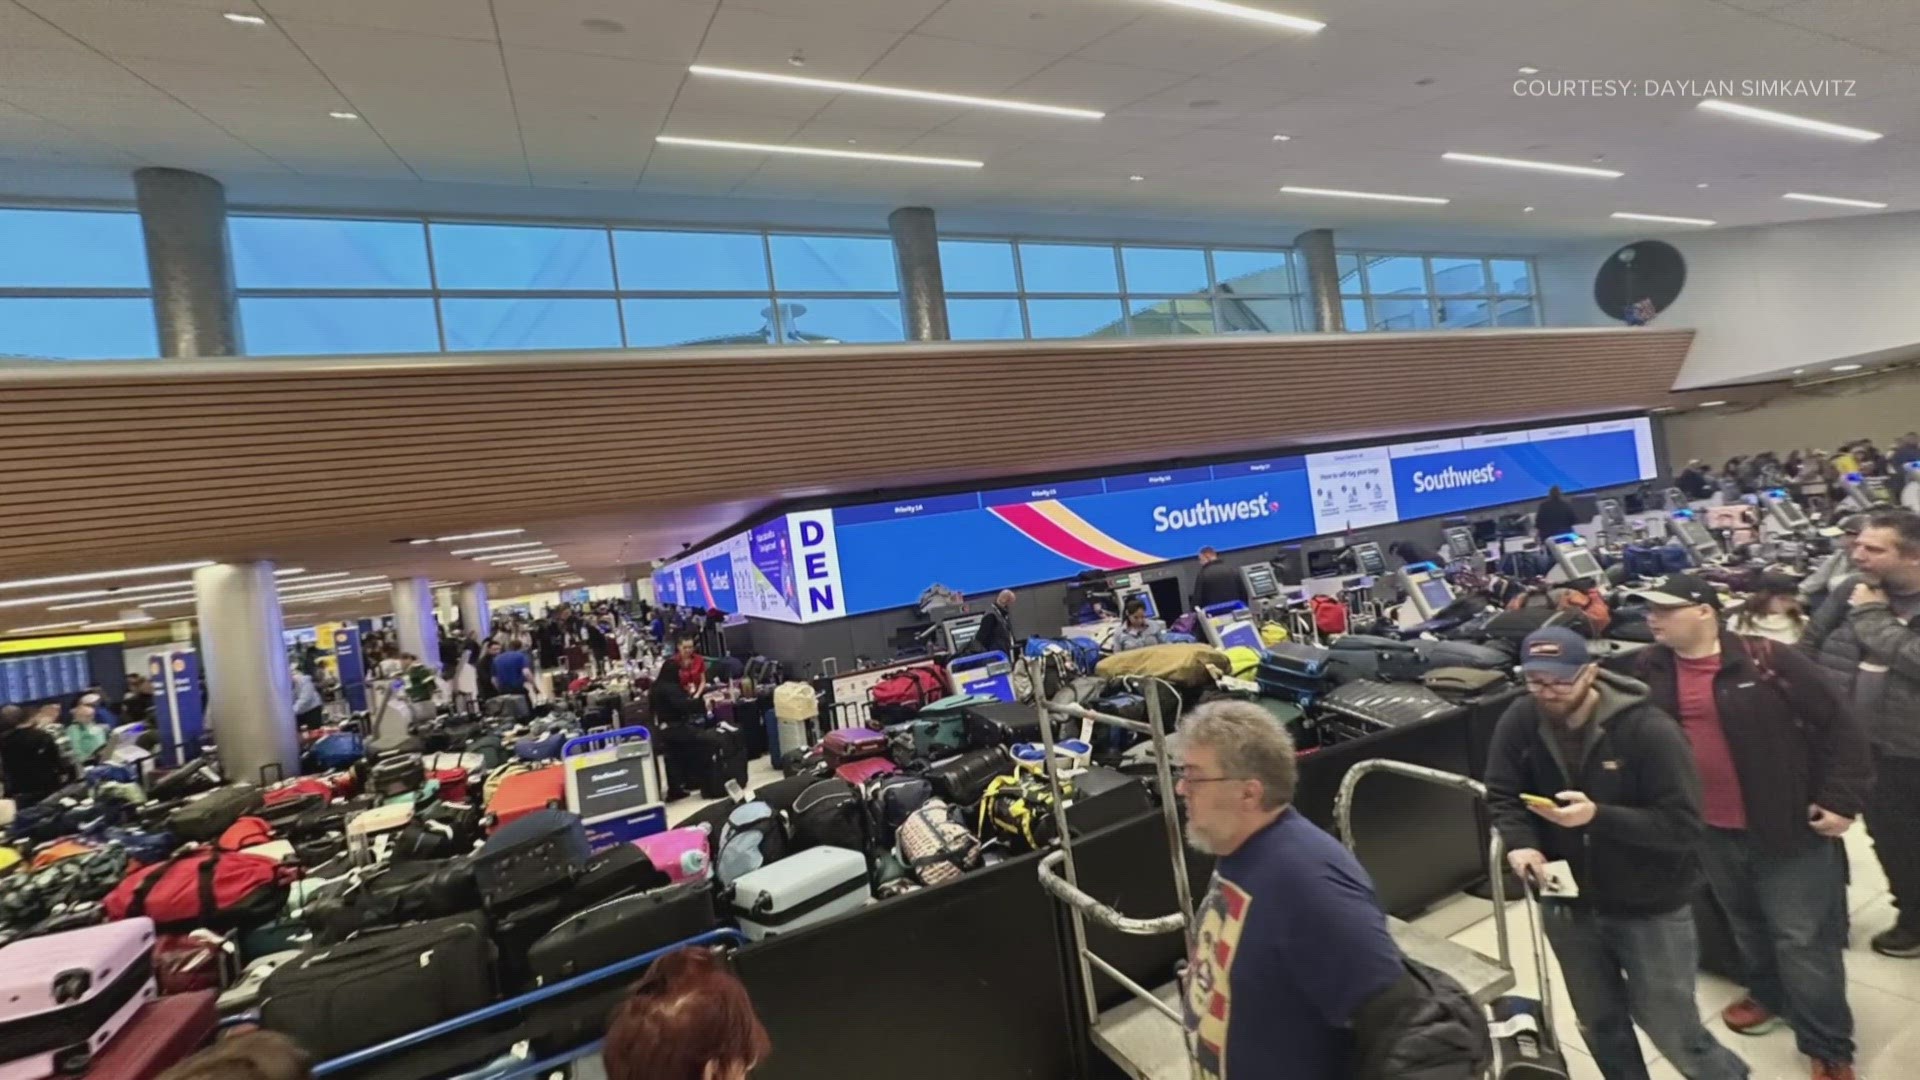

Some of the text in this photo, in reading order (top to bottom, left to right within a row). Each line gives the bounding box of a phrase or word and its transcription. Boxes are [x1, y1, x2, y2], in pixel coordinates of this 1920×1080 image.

[1413, 462, 1496, 493] Southwest
[1153, 492, 1270, 532] Southwest
[799, 519, 835, 614] DEN
